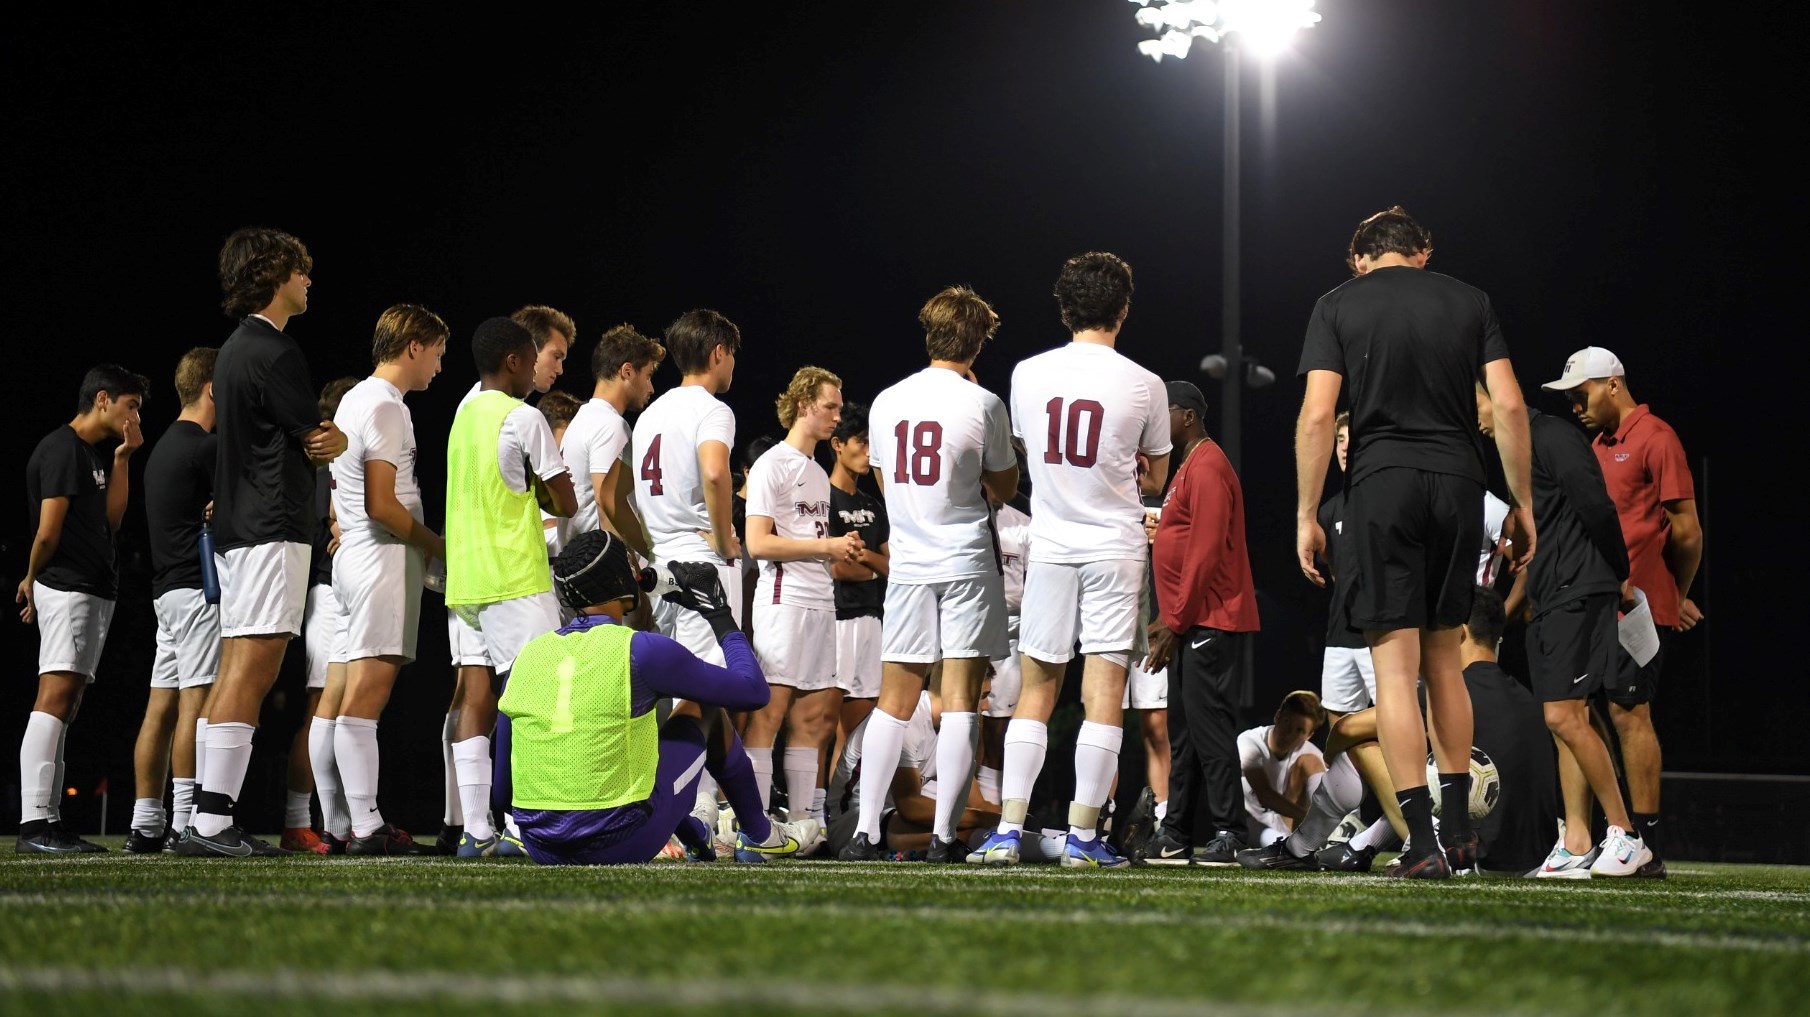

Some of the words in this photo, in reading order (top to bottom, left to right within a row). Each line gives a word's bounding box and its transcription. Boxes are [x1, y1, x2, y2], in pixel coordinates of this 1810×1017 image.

[641, 433, 663, 496] 4
[894, 419, 943, 486] 18
[1044, 397, 1105, 468] 10
[795, 501, 830, 517] MI
[551, 656, 576, 732] 1
